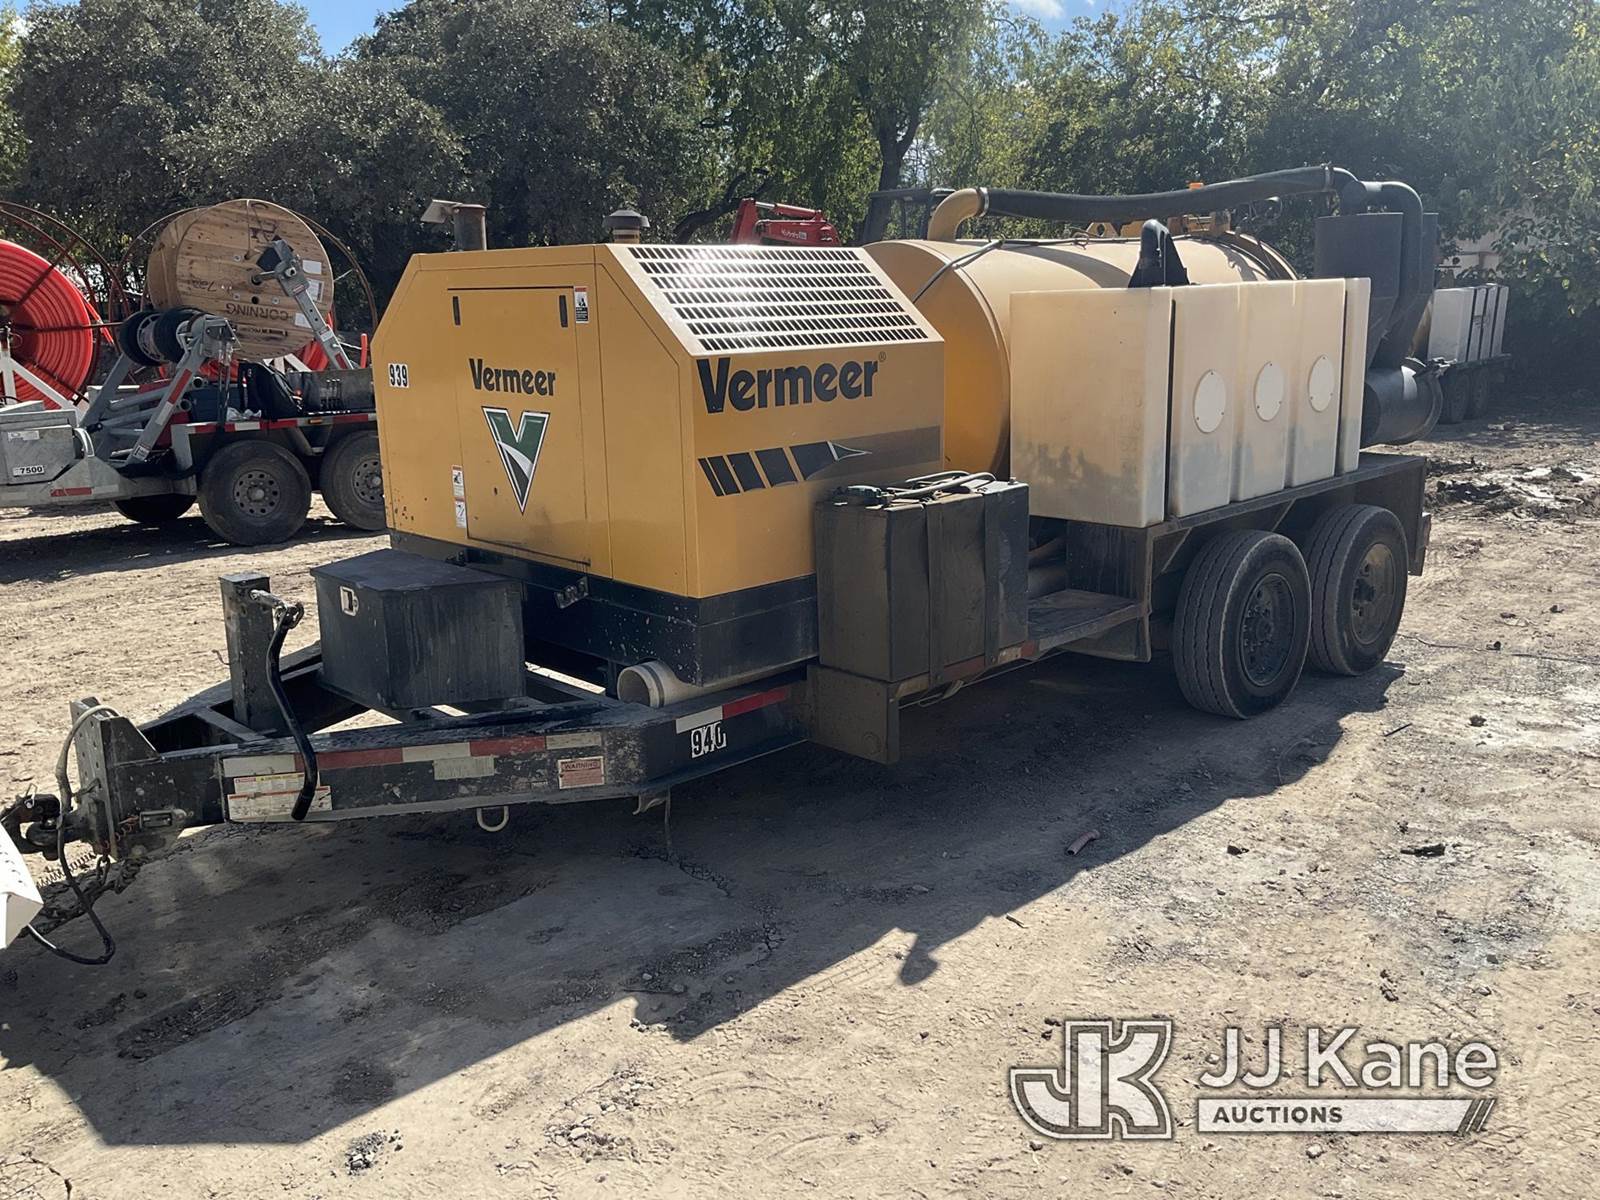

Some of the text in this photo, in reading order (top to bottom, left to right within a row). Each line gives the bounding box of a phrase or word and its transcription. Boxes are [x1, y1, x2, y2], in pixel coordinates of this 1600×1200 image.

[226, 302, 289, 321] CORNING
[389, 364, 409, 387] 939
[469, 358, 556, 396] Vermeer
[696, 356, 879, 414] Vermeer
[20, 466, 43, 474] 7500
[563, 760, 599, 770] WARNING
